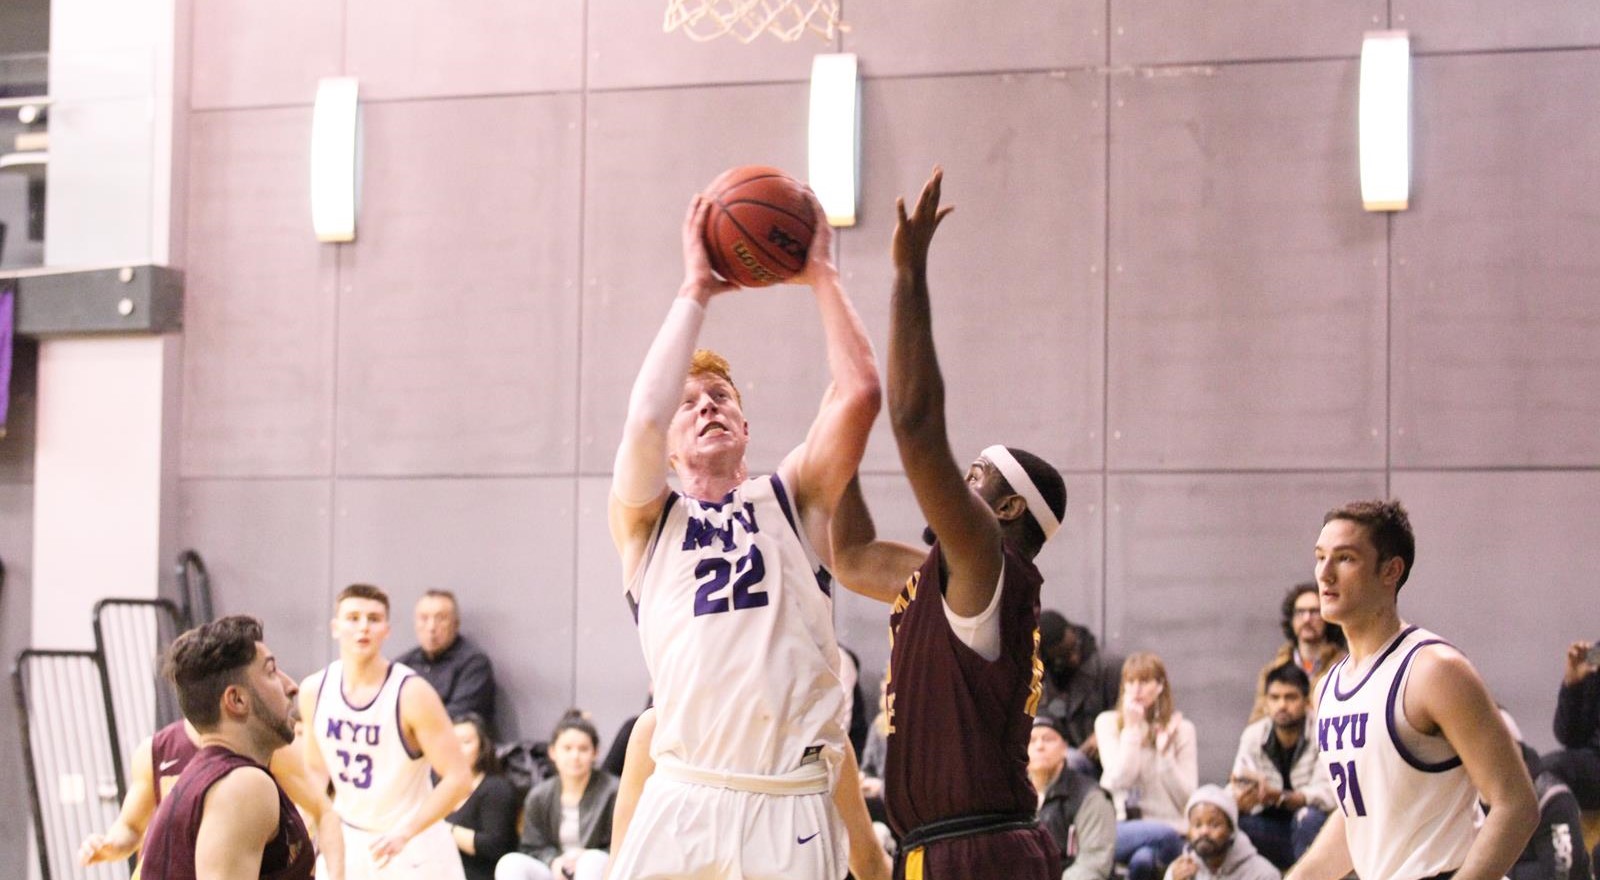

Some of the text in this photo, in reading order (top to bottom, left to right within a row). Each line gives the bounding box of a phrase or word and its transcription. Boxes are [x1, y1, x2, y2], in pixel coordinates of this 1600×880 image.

[682, 502, 759, 552] NYU
[694, 544, 769, 617] 22
[326, 718, 380, 746] NYU
[1319, 713, 1369, 752] NYU
[1329, 760, 1367, 818] 21
